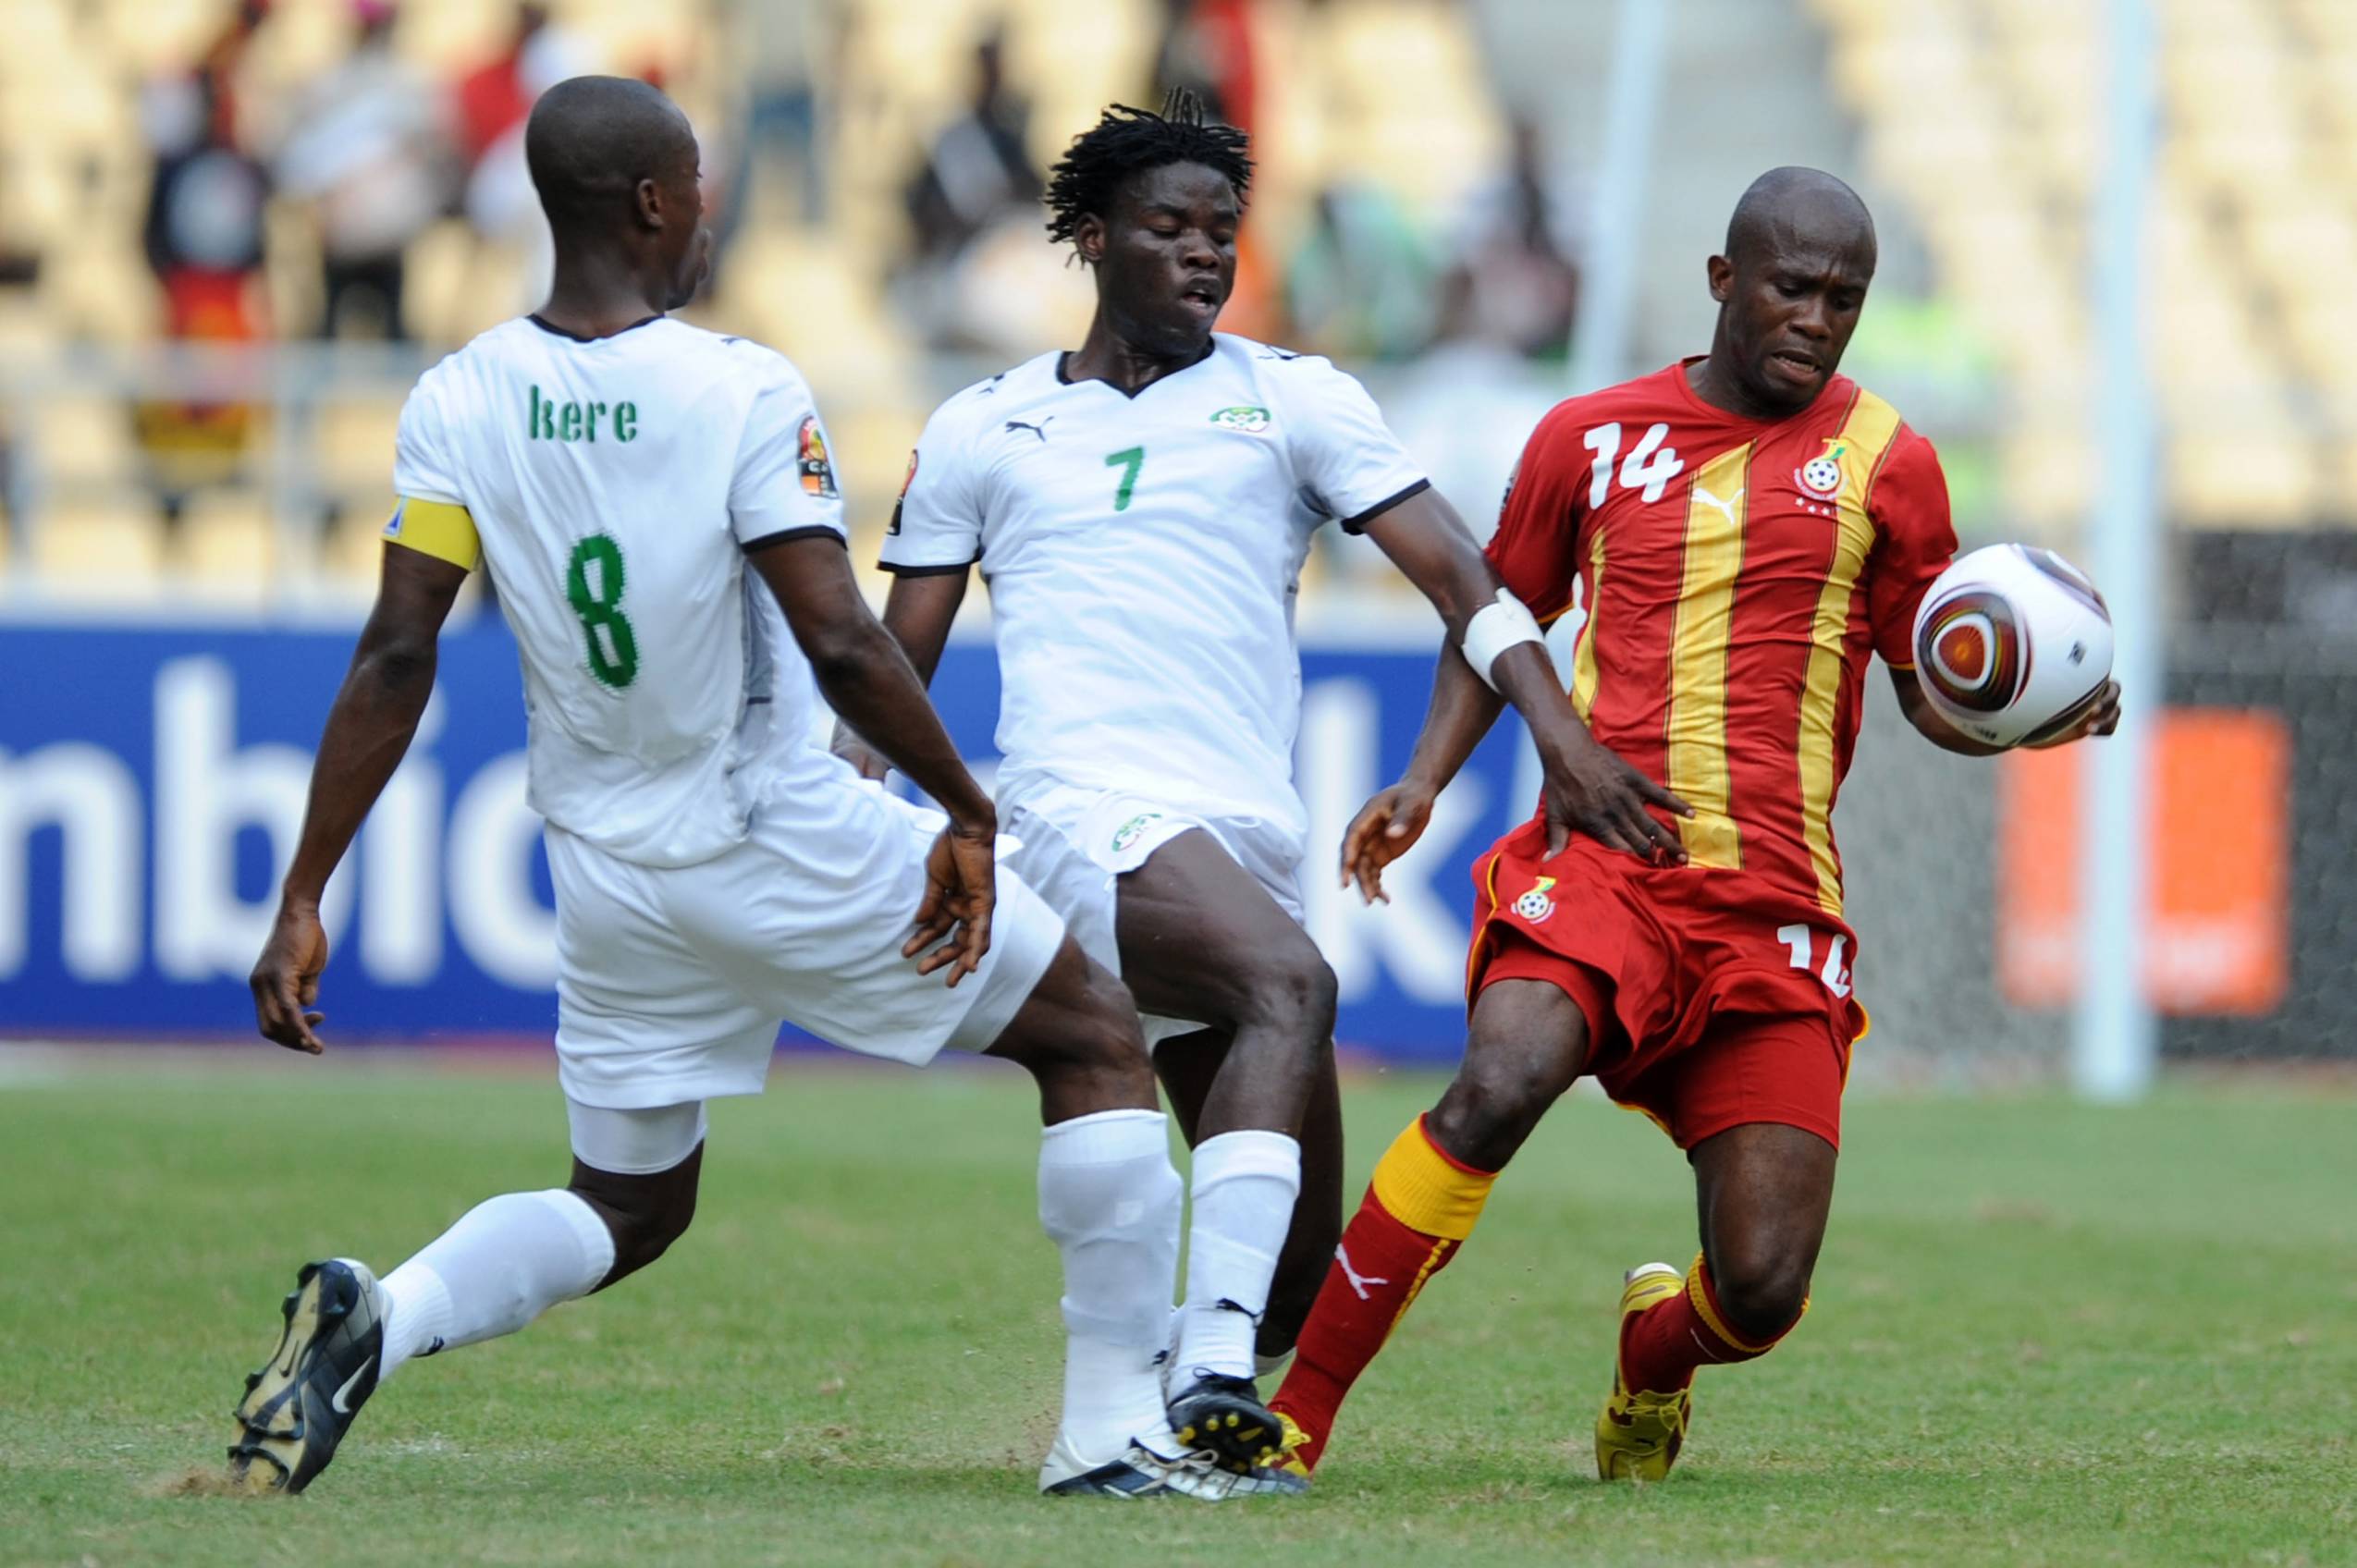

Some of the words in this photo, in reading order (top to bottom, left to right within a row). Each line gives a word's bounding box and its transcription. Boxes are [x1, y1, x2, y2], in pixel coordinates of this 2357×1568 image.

[1104, 444, 1145, 512] 7
[1583, 422, 1685, 510] 14
[566, 531, 639, 689] 8
[1776, 923, 1851, 999] 14
